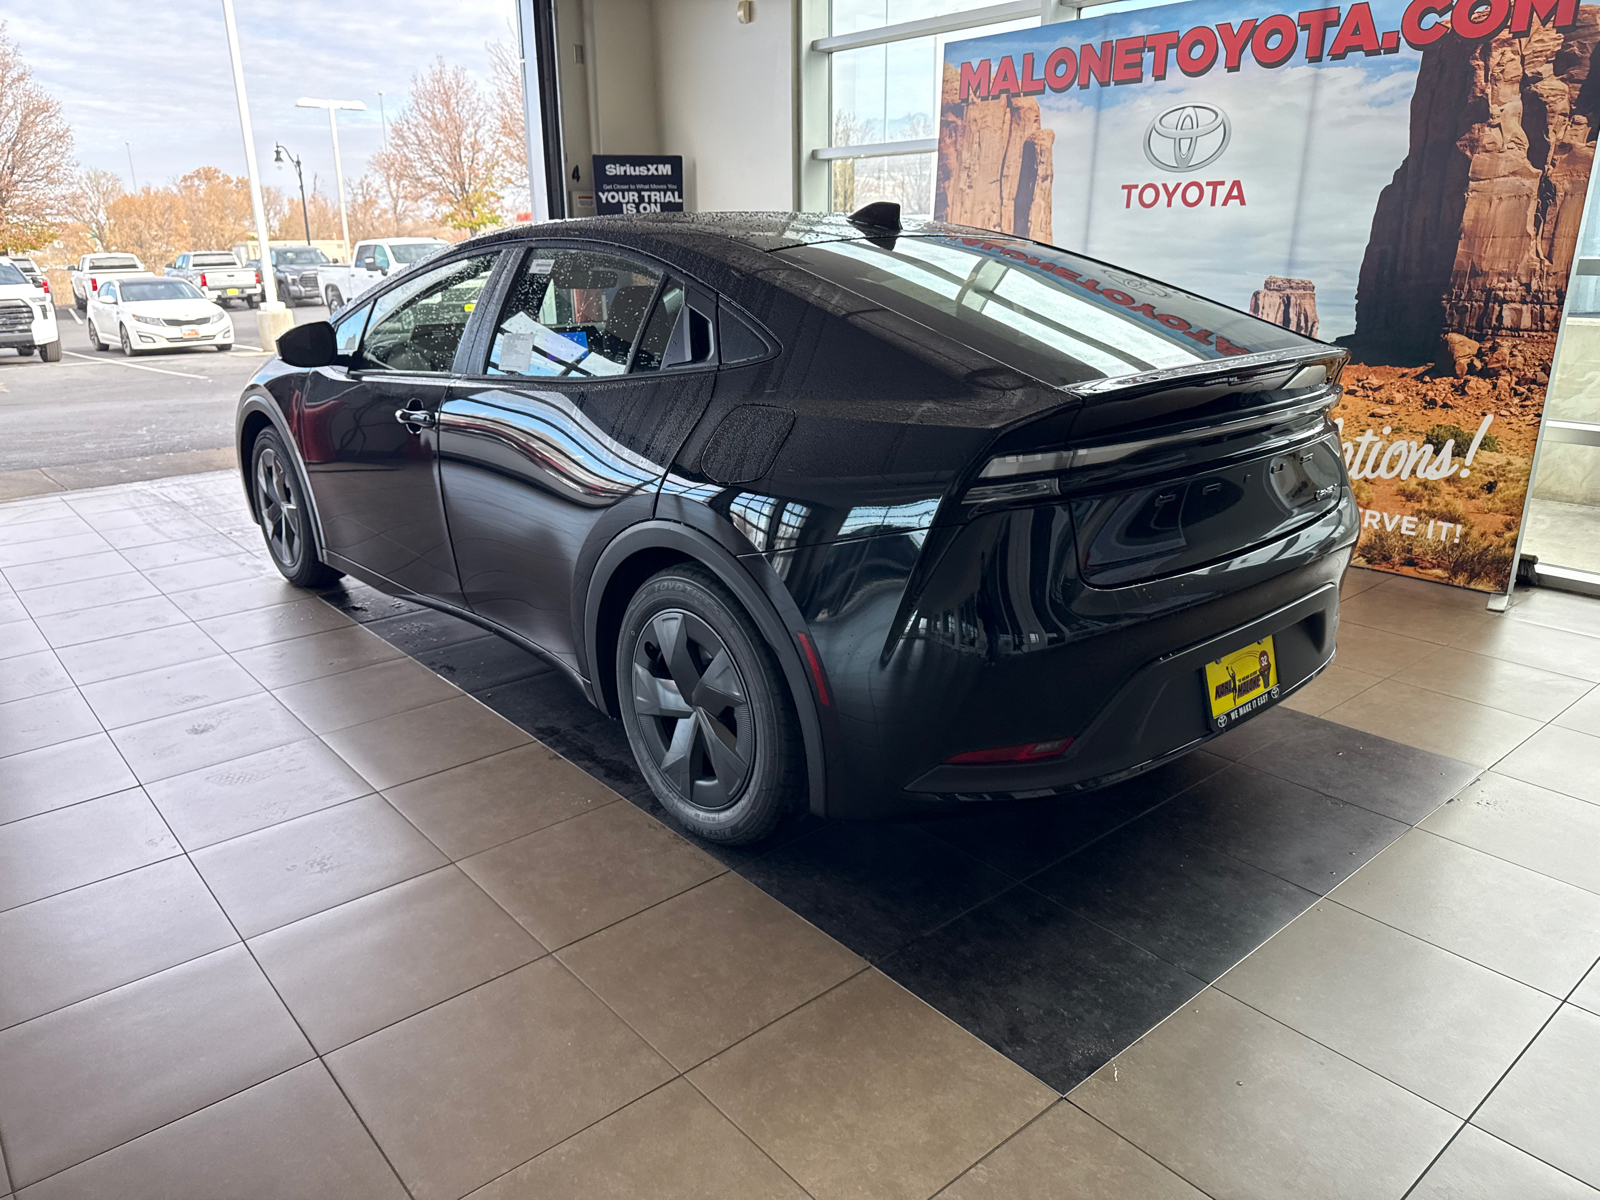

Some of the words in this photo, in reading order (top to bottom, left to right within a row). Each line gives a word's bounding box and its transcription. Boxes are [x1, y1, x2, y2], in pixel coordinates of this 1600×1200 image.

[959, 0, 1579, 101] MALONETOYOTA.COM
[572, 165, 580, 182] 4
[605, 163, 672, 176] SiriusXM
[598, 191, 639, 203] YOUR
[641, 191, 683, 203] TRIAL
[1121, 180, 1247, 209] TOYOTA
[622, 203, 637, 214] IS
[639, 203, 661, 213] ON
[1358, 507, 1419, 536] RVE
[1427, 519, 1463, 544] IT!
[1260, 655, 1268, 666] 32
[1230, 710, 1238, 720] WE
[1239, 703, 1252, 716] MAKE
[1257, 694, 1268, 706] EASY
